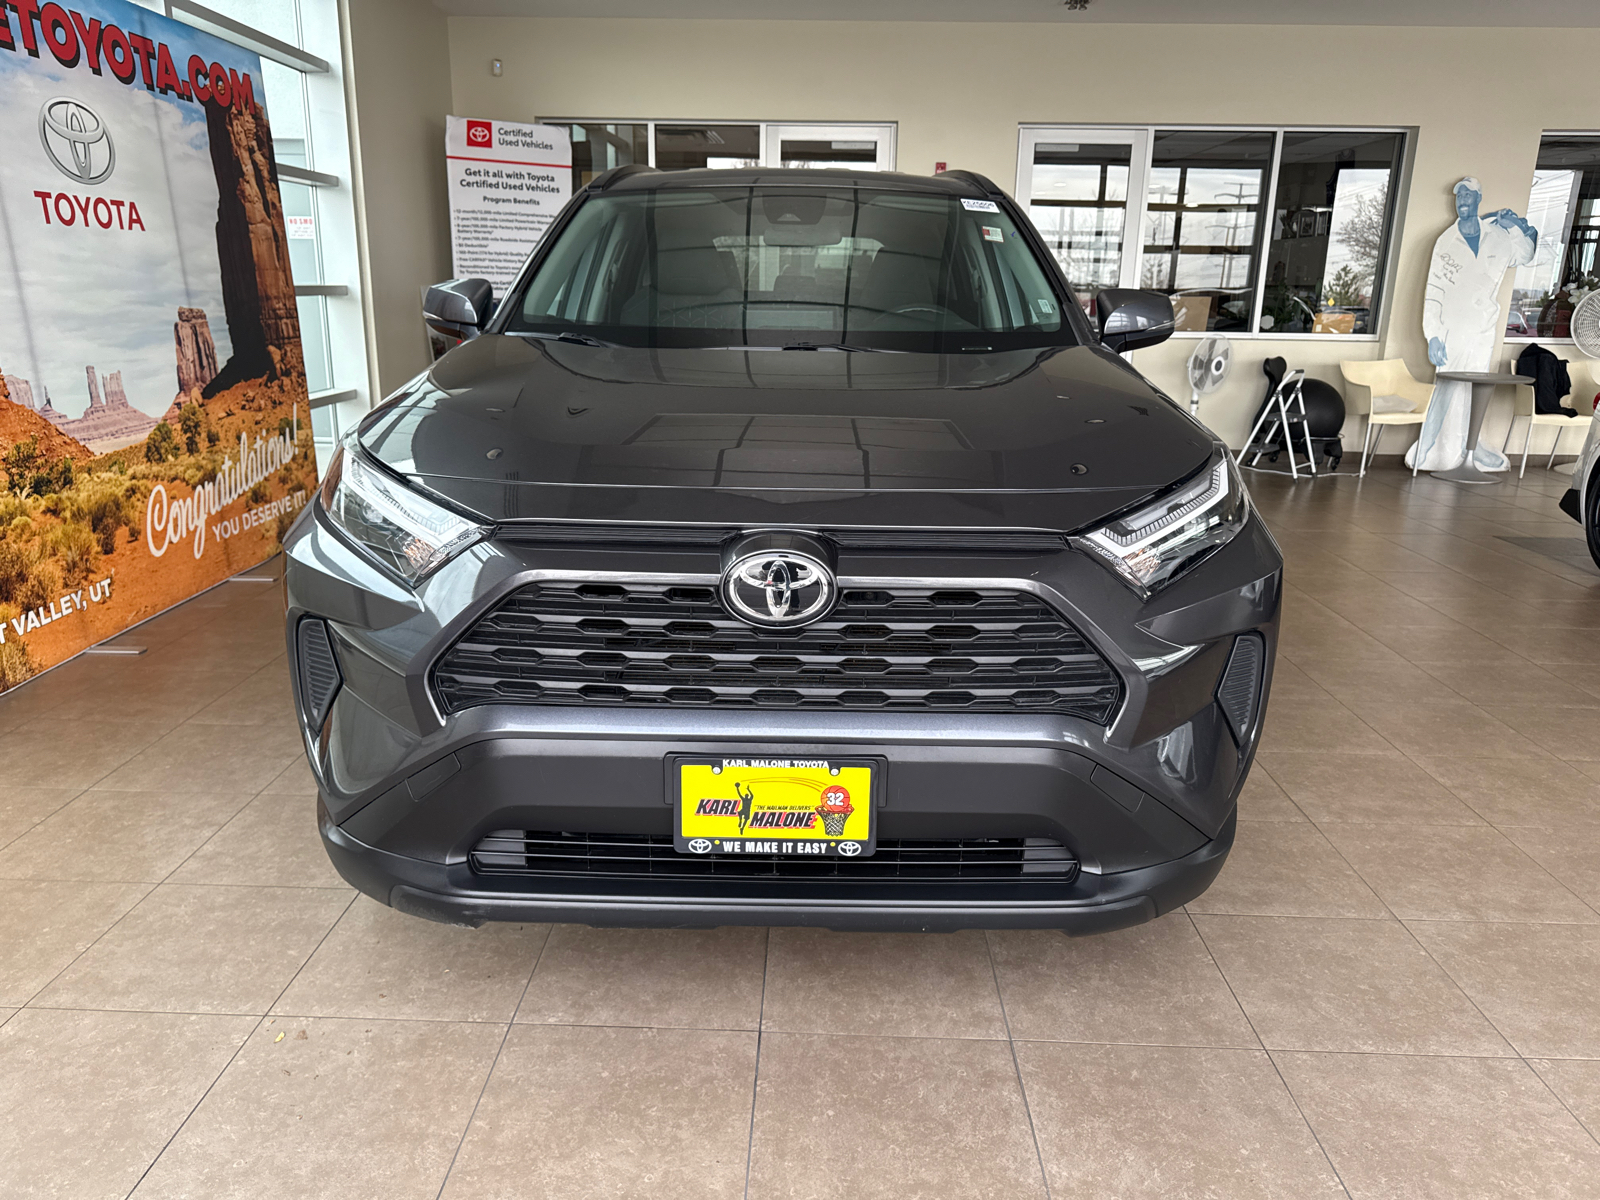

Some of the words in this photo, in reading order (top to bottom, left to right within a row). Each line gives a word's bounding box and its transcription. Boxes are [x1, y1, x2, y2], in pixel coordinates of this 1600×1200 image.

[498, 127, 533, 139] Certified
[498, 138, 519, 147] Used
[520, 139, 553, 151] Vehicles
[465, 168, 482, 178] Get
[483, 169, 490, 177] it
[492, 169, 503, 179] all
[505, 171, 525, 180] with
[527, 172, 555, 183] Toyota
[460, 178, 500, 190] Certified
[501, 181, 523, 191] Used
[525, 182, 560, 194] Vehicles
[483, 195, 512, 205] Program
[513, 197, 540, 206] Benefits
[33, 190, 146, 232] TOYOTA
[147, 402, 299, 560] Congratulations!
[212, 516, 241, 542] YOU
[243, 495, 293, 531] DESERVE
[293, 489, 306, 512] IT!
[11, 589, 88, 637] VALLEY,
[88, 578, 112, 603] UT
[722, 759, 749, 768] KARL
[751, 760, 791, 769] MALONE
[792, 760, 829, 769] TOYOTA
[826, 792, 844, 806] 32
[695, 799, 741, 816] KARL
[749, 811, 817, 829] MALONE
[723, 841, 741, 852] WE
[745, 841, 778, 853] MAKE
[783, 842, 793, 853] IT
[797, 842, 827, 854] EASY
